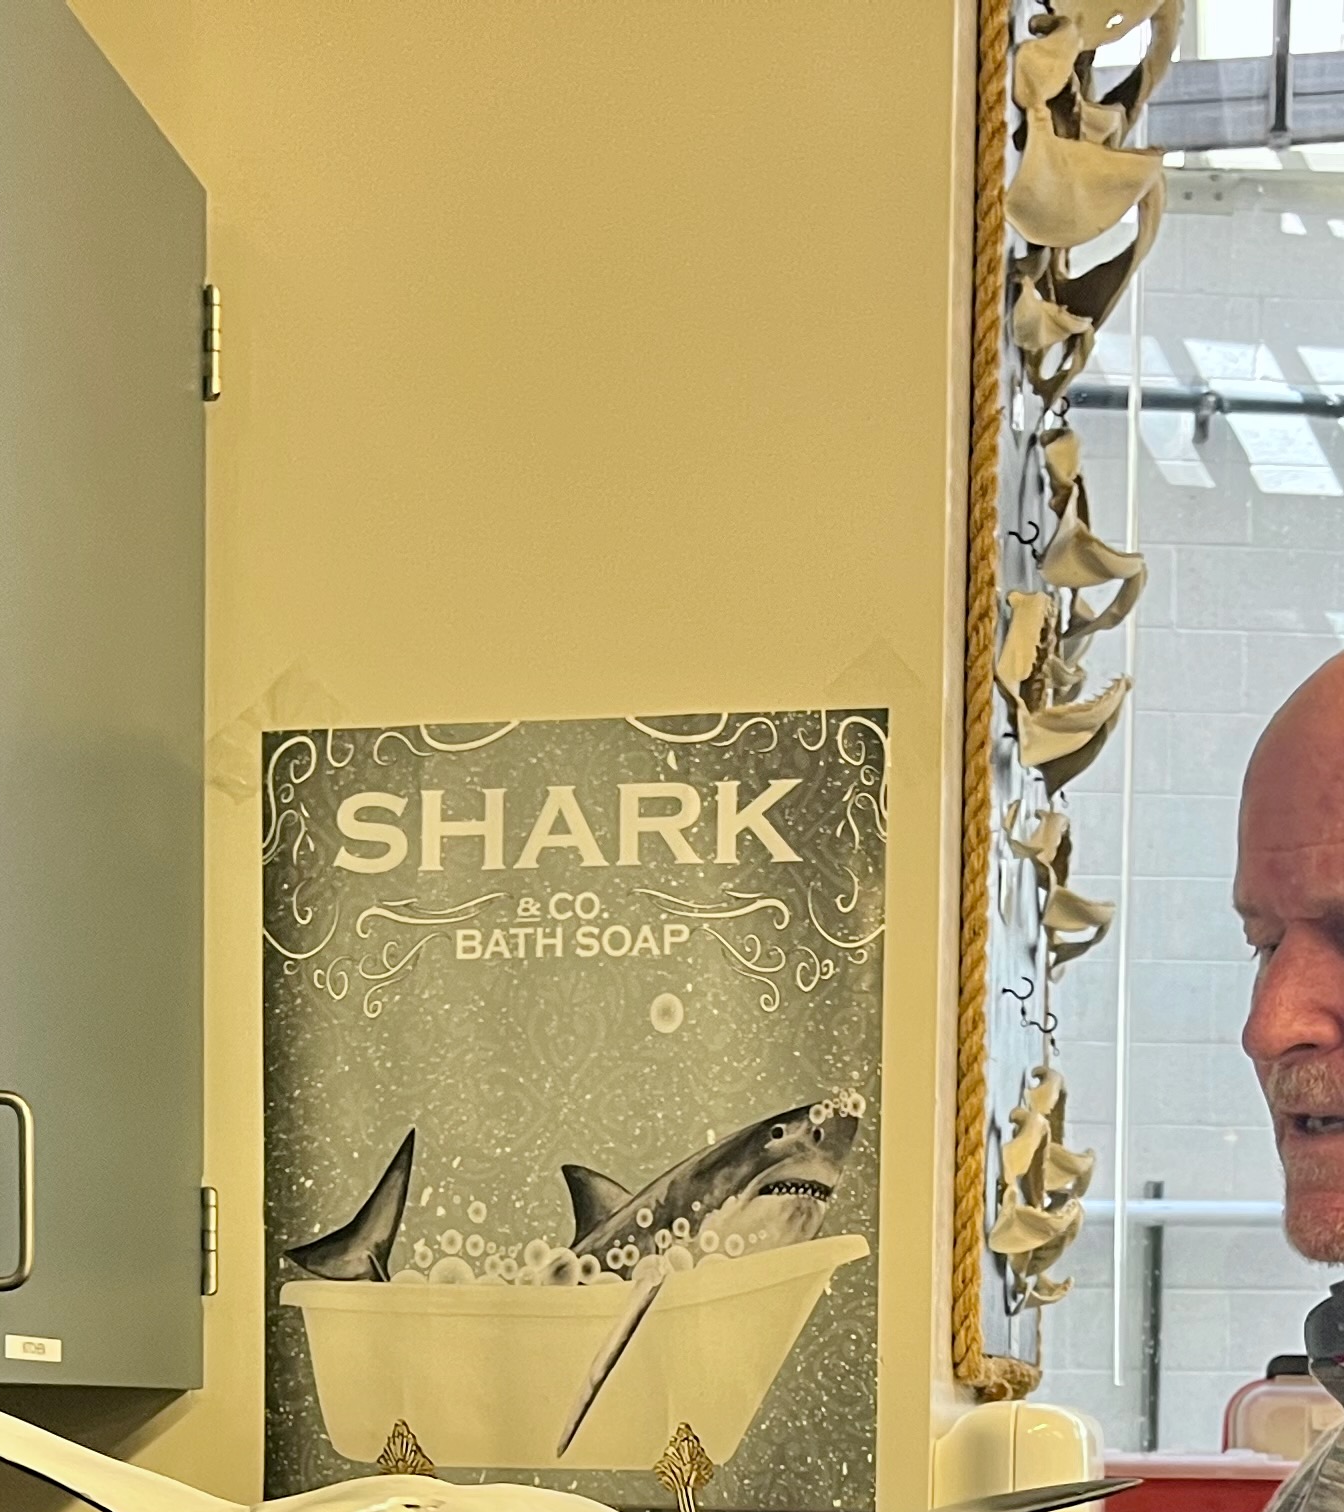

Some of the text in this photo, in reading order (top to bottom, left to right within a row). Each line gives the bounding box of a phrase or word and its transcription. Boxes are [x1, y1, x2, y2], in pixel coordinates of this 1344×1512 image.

[333, 777, 805, 875] SHARK
[513, 896, 542, 924] &
[454, 922, 691, 961] BATH SOAP
